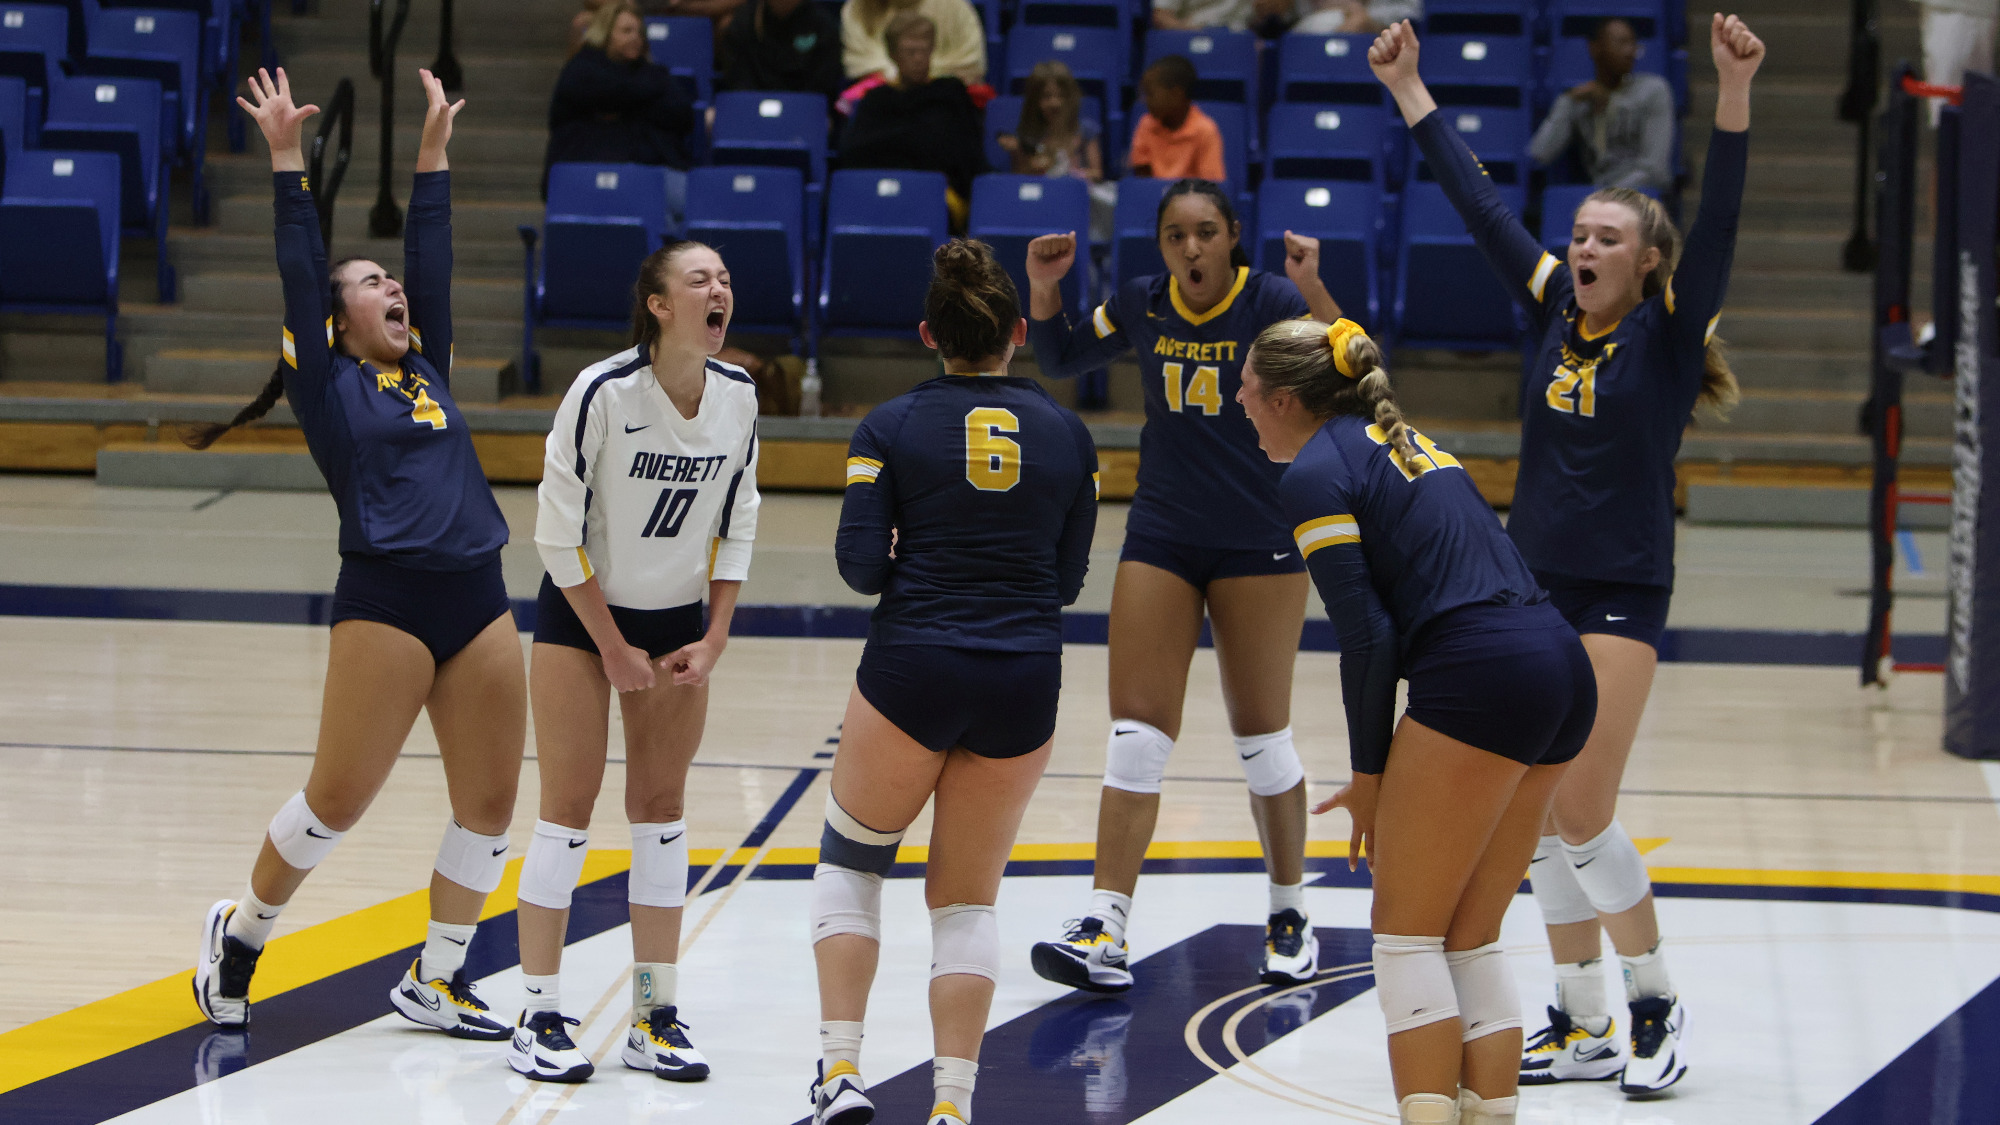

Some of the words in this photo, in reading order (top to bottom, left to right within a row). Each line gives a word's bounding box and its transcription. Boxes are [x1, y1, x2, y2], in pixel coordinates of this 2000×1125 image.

[1153, 335, 1238, 361] AVERETT
[411, 387, 447, 430] 4
[1162, 361, 1223, 416] 14
[1546, 364, 1597, 418] 21
[628, 451, 728, 482] AVERETT
[965, 406, 1021, 492] 6
[641, 488, 699, 538] 10
